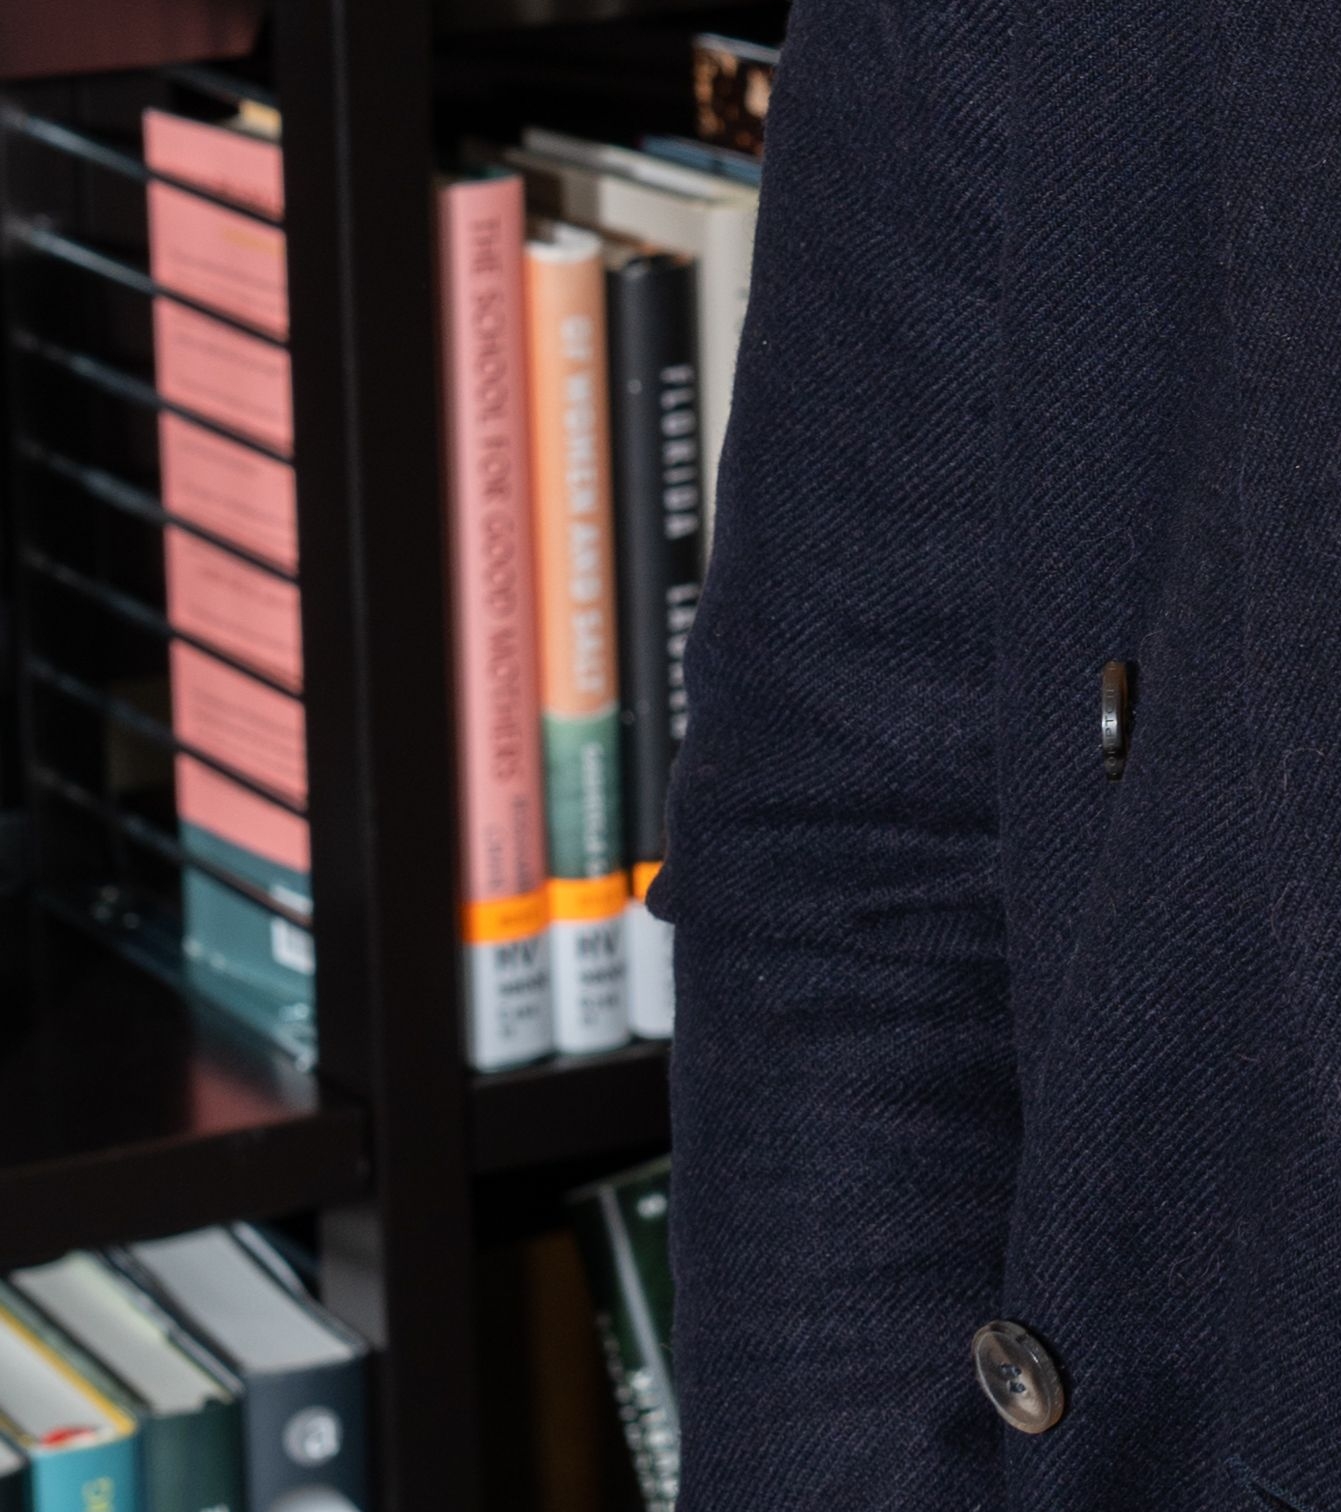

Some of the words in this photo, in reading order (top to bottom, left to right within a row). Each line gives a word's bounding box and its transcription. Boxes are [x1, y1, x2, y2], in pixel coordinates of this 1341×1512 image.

[471, 216, 502, 273] THE
[473, 290, 507, 426] SCHOOL
[479, 435, 511, 499] FOR
[564, 371, 599, 514] WOMEN
[661, 363, 699, 542] FLORIDA
[481, 511, 515, 613] GOOD
[568, 522, 603, 600] AND
[485, 623, 524, 780] MOTHERS
[572, 608, 605, 694] SALT
